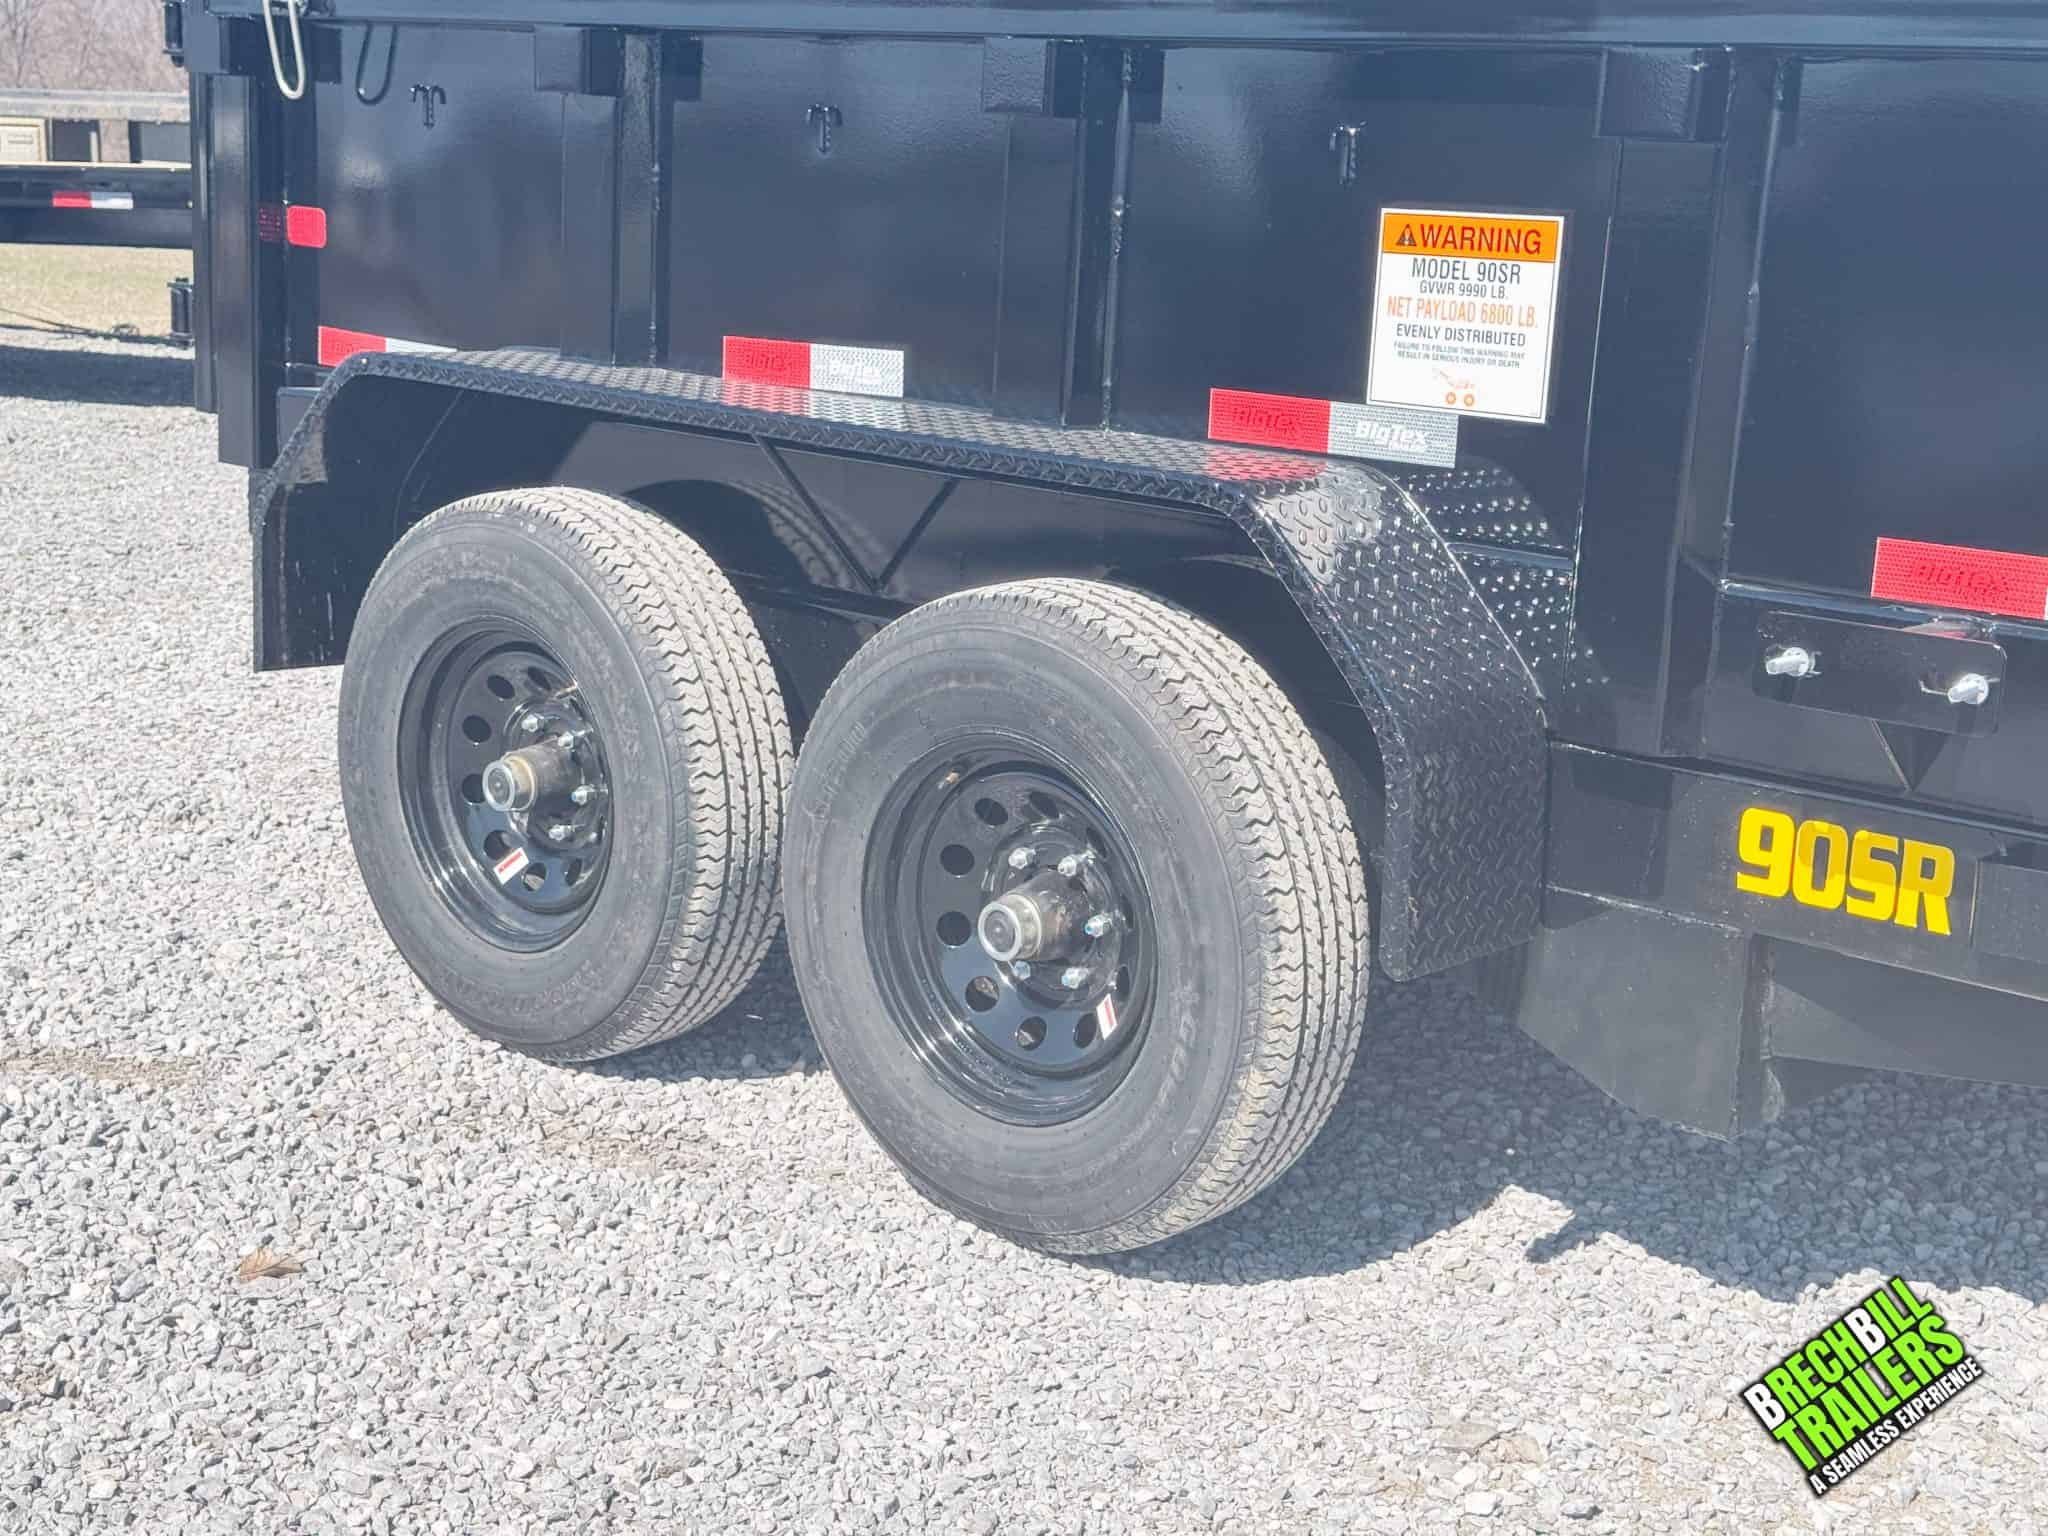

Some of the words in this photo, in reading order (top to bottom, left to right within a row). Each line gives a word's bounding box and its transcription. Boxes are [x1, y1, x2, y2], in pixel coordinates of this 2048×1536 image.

[1420, 223, 1542, 255] WARNING
[1411, 257, 1470, 281] MODEL
[1477, 261, 1521, 285] 90SR
[1419, 280, 1455, 296] GVWR
[1458, 283, 1487, 298] 9990
[1490, 285, 1509, 300] LB.
[1387, 296, 1413, 319] NET
[1416, 299, 1476, 323] PAYLOAD
[1481, 302, 1513, 326] 6800
[1518, 305, 1539, 329] LB.
[1396, 323, 1441, 340] EVENLY
[1444, 327, 1526, 347] DISTRIBUTED
[1736, 807, 1956, 936] 90SR
